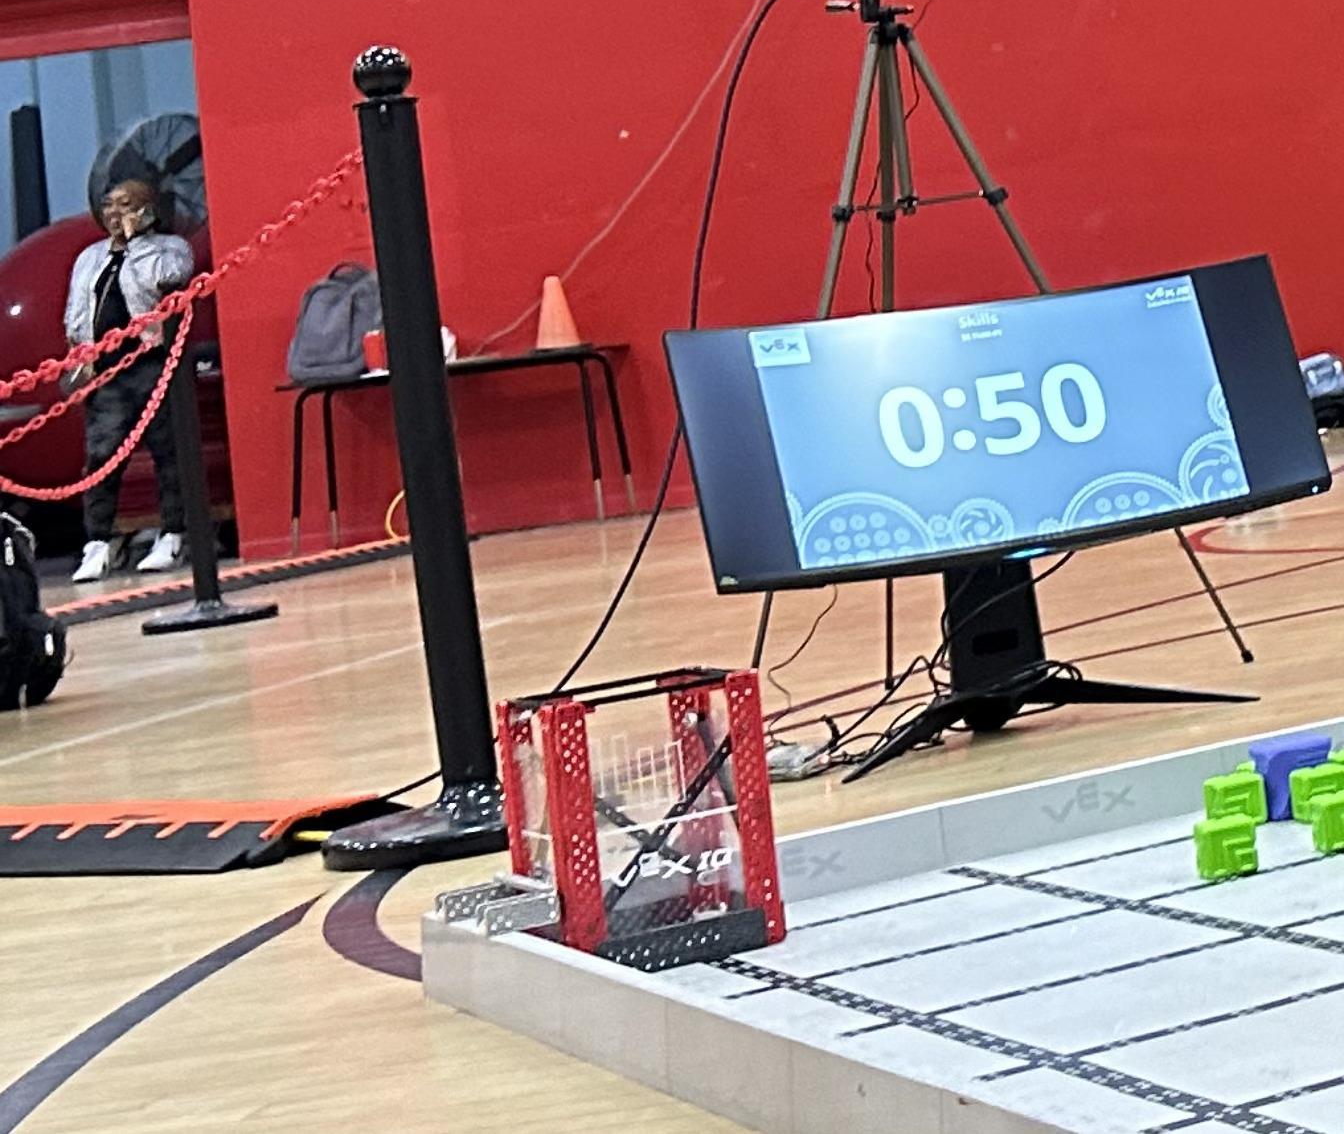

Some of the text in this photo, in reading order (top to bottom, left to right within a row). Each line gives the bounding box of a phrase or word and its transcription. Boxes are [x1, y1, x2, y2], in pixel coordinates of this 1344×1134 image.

[958, 311, 999, 329] Skills
[760, 339, 800, 353] VEX
[879, 363, 1107, 468] 0:50
[1041, 781, 1135, 823] VEX
